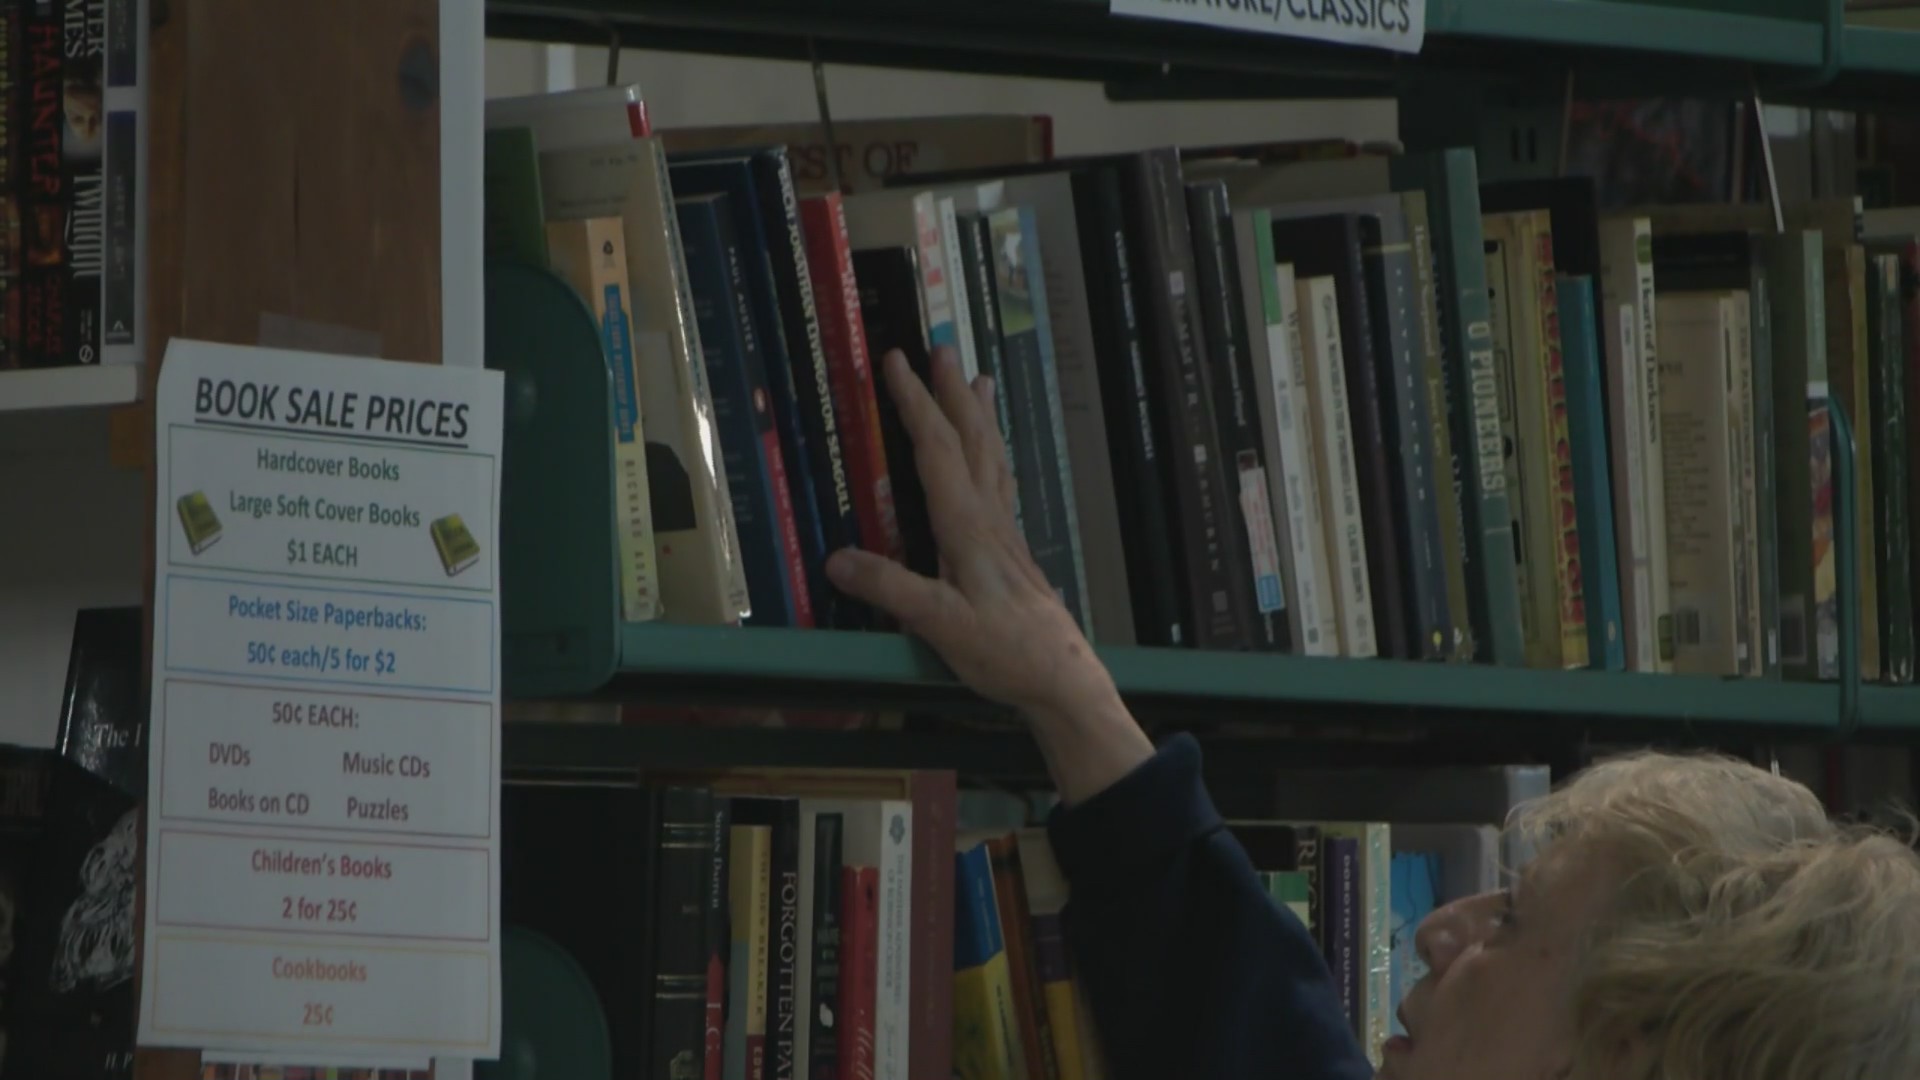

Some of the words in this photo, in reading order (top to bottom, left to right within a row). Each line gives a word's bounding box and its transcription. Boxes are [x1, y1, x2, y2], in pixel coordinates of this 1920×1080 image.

[862, 140, 919, 179] OF
[834, 202, 848, 239] THE
[726, 245, 743, 289] PAUL
[1640, 276, 1652, 331] Heart
[734, 291, 755, 353] AUSTER
[1467, 319, 1489, 340] O
[774, 166, 796, 220] BACH
[786, 221, 816, 319] JONATHAN
[805, 320, 837, 432] LIVINGSTON
[824, 433, 853, 518] SEAGULL
[1738, 324, 1748, 359] THE
[195, 378, 280, 421] BOOK
[285, 387, 358, 428] SALE
[365, 395, 469, 440] PRICES
[1644, 355, 1658, 444] Darkness
[1469, 348, 1507, 501] PIONEERS!
[257, 448, 343, 476] Hardcover
[348, 457, 400, 481] Books
[229, 491, 273, 519] Large
[276, 494, 310, 520] Soft
[315, 499, 363, 523] Cover
[369, 505, 421, 528] Books
[623, 458, 643, 539] RICHARD
[775, 476, 792, 511] NEW
[782, 513, 800, 552] YORK
[287, 540, 307, 565] $1
[312, 542, 358, 567] EACH
[632, 549, 650, 610] ADAMS
[228, 596, 282, 620] Pocket
[286, 600, 319, 623] Size
[324, 605, 427, 632] Paperbacks:
[247, 642, 276, 665] 50¢
[281, 644, 341, 671] each/5
[345, 649, 370, 670] for
[374, 651, 396, 677] $2
[272, 702, 303, 725] 50¢
[308, 705, 360, 728] EACH:
[95, 723, 131, 748] The
[208, 743, 251, 766] DVDs
[342, 752, 395, 776] Music
[398, 755, 431, 778] CDs
[208, 788, 255, 813] Books
[259, 795, 281, 813] on
[285, 793, 310, 815] CD
[346, 797, 409, 821] Puzzles
[340, 855, 393, 879] Books
[282, 897, 293, 919] 2
[298, 897, 322, 921] for
[327, 899, 358, 922] 25¢
[1343, 854, 1352, 941] DOROTHY
[271, 957, 367, 983] Cookbooks
[777, 871, 797, 1033] FORGOTTEN
[756, 935, 766, 1016] BREAKER
[302, 1003, 334, 1026] 25¢
